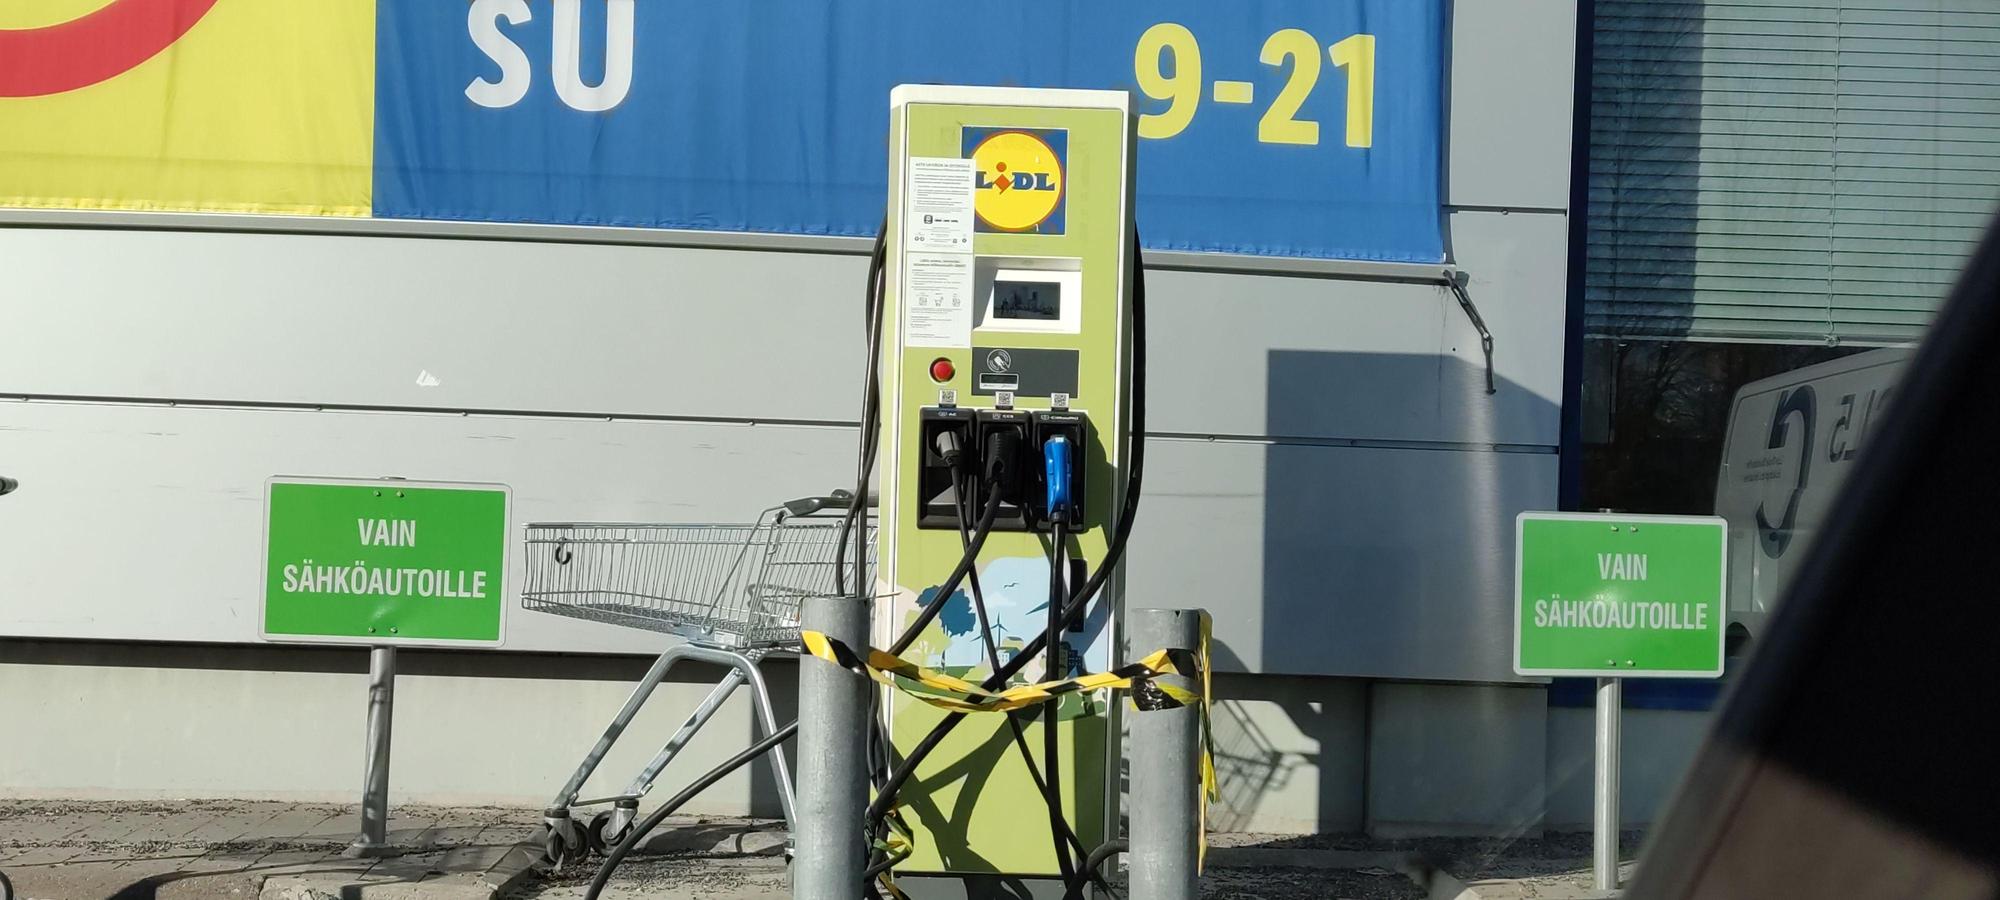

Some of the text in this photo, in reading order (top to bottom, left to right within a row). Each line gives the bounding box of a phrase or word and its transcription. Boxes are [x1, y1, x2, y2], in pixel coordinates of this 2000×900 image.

[465, 0, 635, 112] SU
[1135, 22, 1376, 148] 9-21
[358, 518, 416, 548] VAIN
[282, 559, 486, 600] SÄHKÖAUTOILLE
[1597, 553, 1647, 581] VAIN
[1534, 594, 1707, 631] SÄHKÖAUTOILLE
